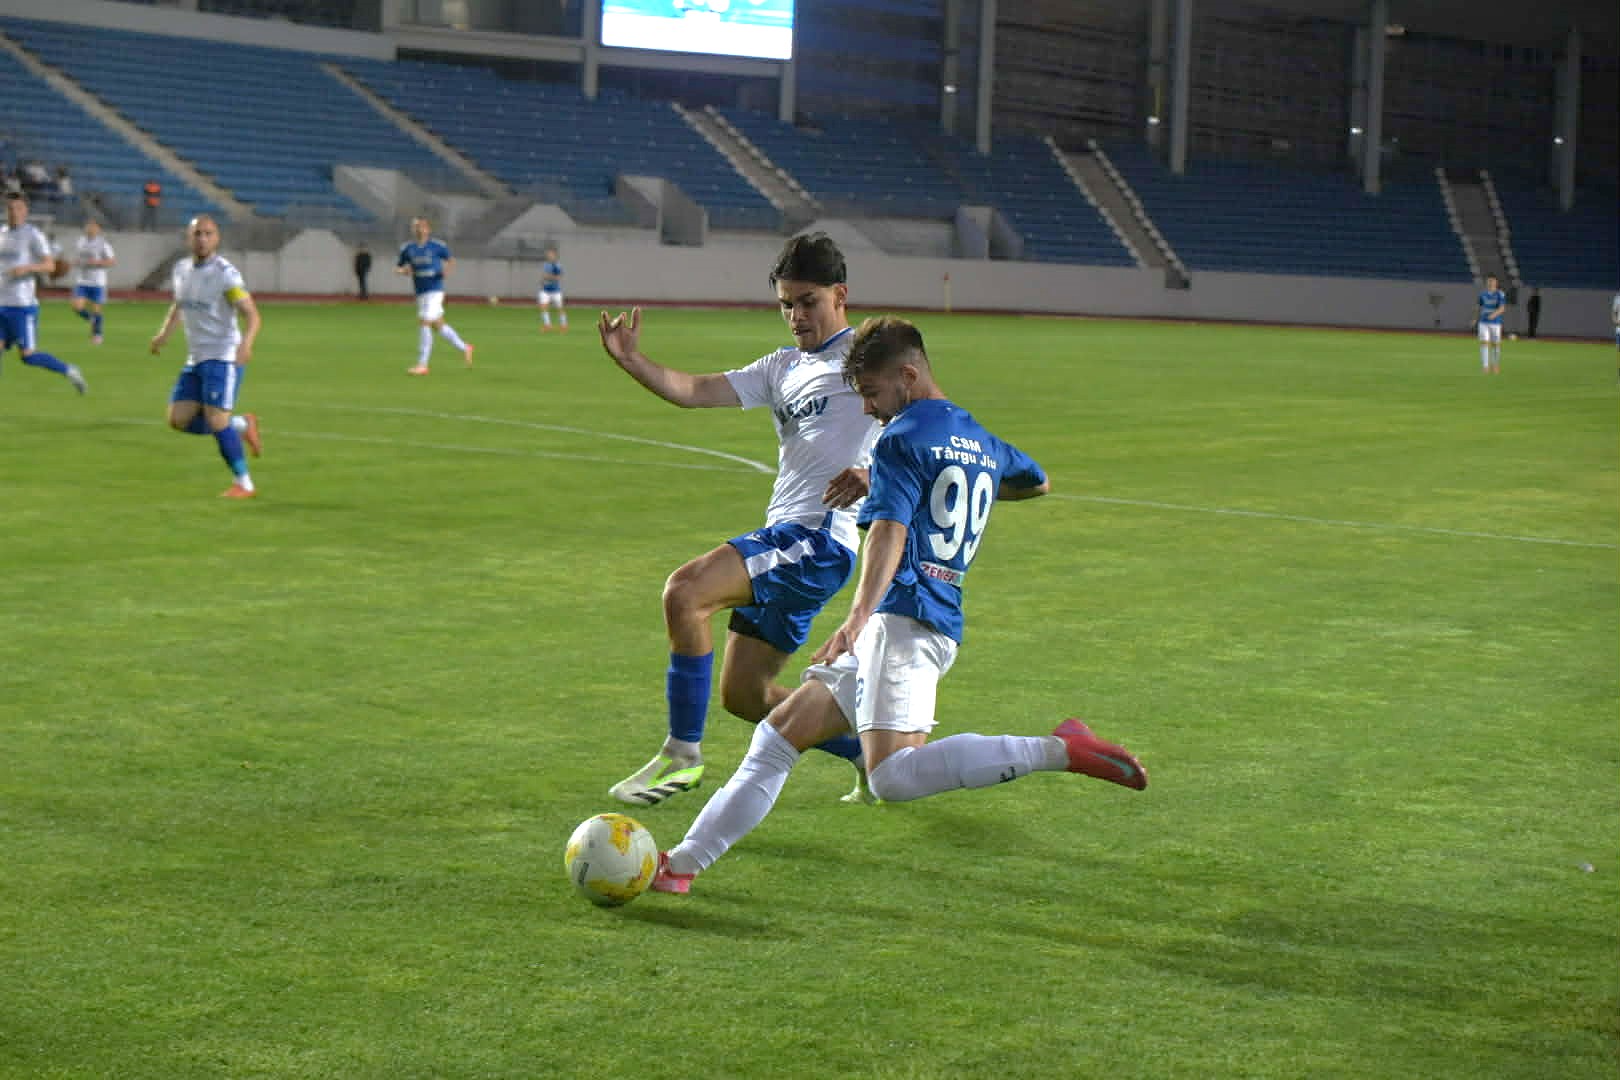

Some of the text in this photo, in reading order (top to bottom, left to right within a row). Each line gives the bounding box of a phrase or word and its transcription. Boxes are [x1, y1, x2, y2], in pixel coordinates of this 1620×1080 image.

[950, 435, 982, 453] CSM
[931, 446, 997, 470] Târgu Jiu
[928, 464, 993, 566] 99
